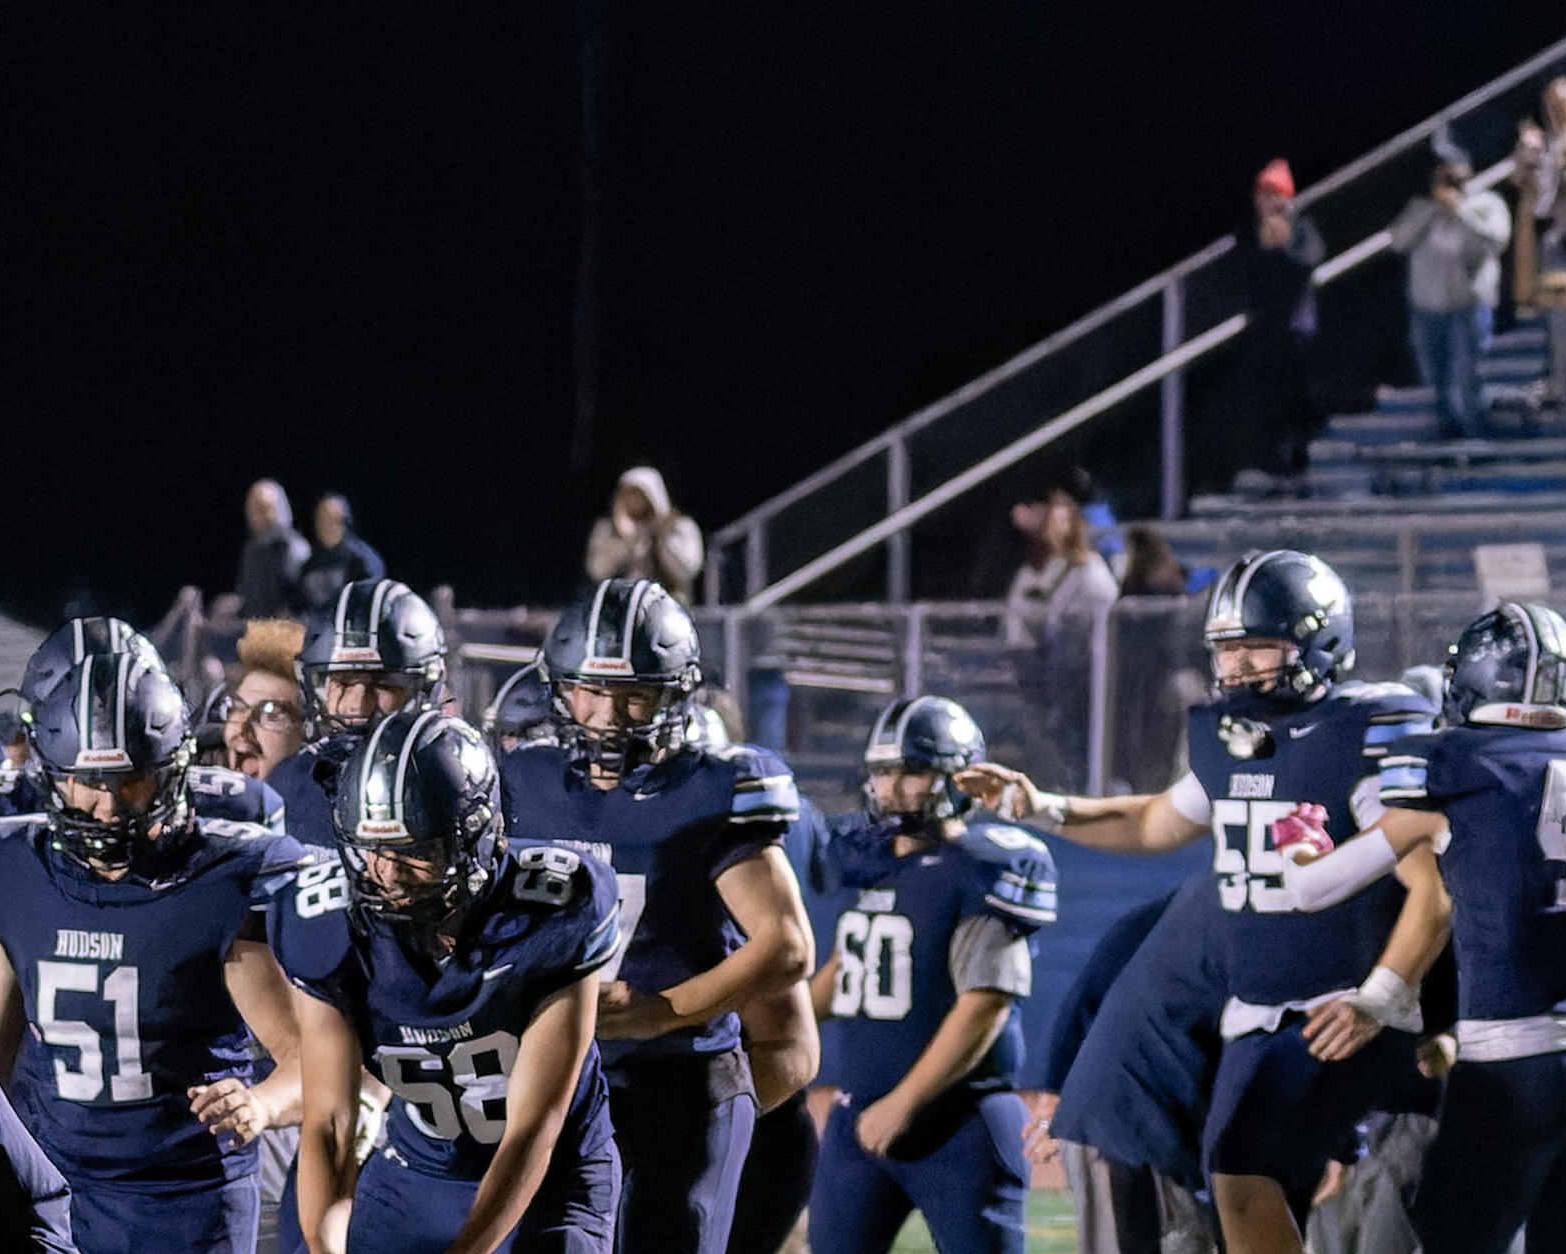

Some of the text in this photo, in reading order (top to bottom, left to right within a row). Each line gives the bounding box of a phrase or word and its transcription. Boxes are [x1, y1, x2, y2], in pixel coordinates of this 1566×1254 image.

[1212, 800, 1299, 913] 55
[54, 929, 125, 960] HUDSON
[831, 910, 914, 1020] 60
[37, 960, 154, 1102] 51
